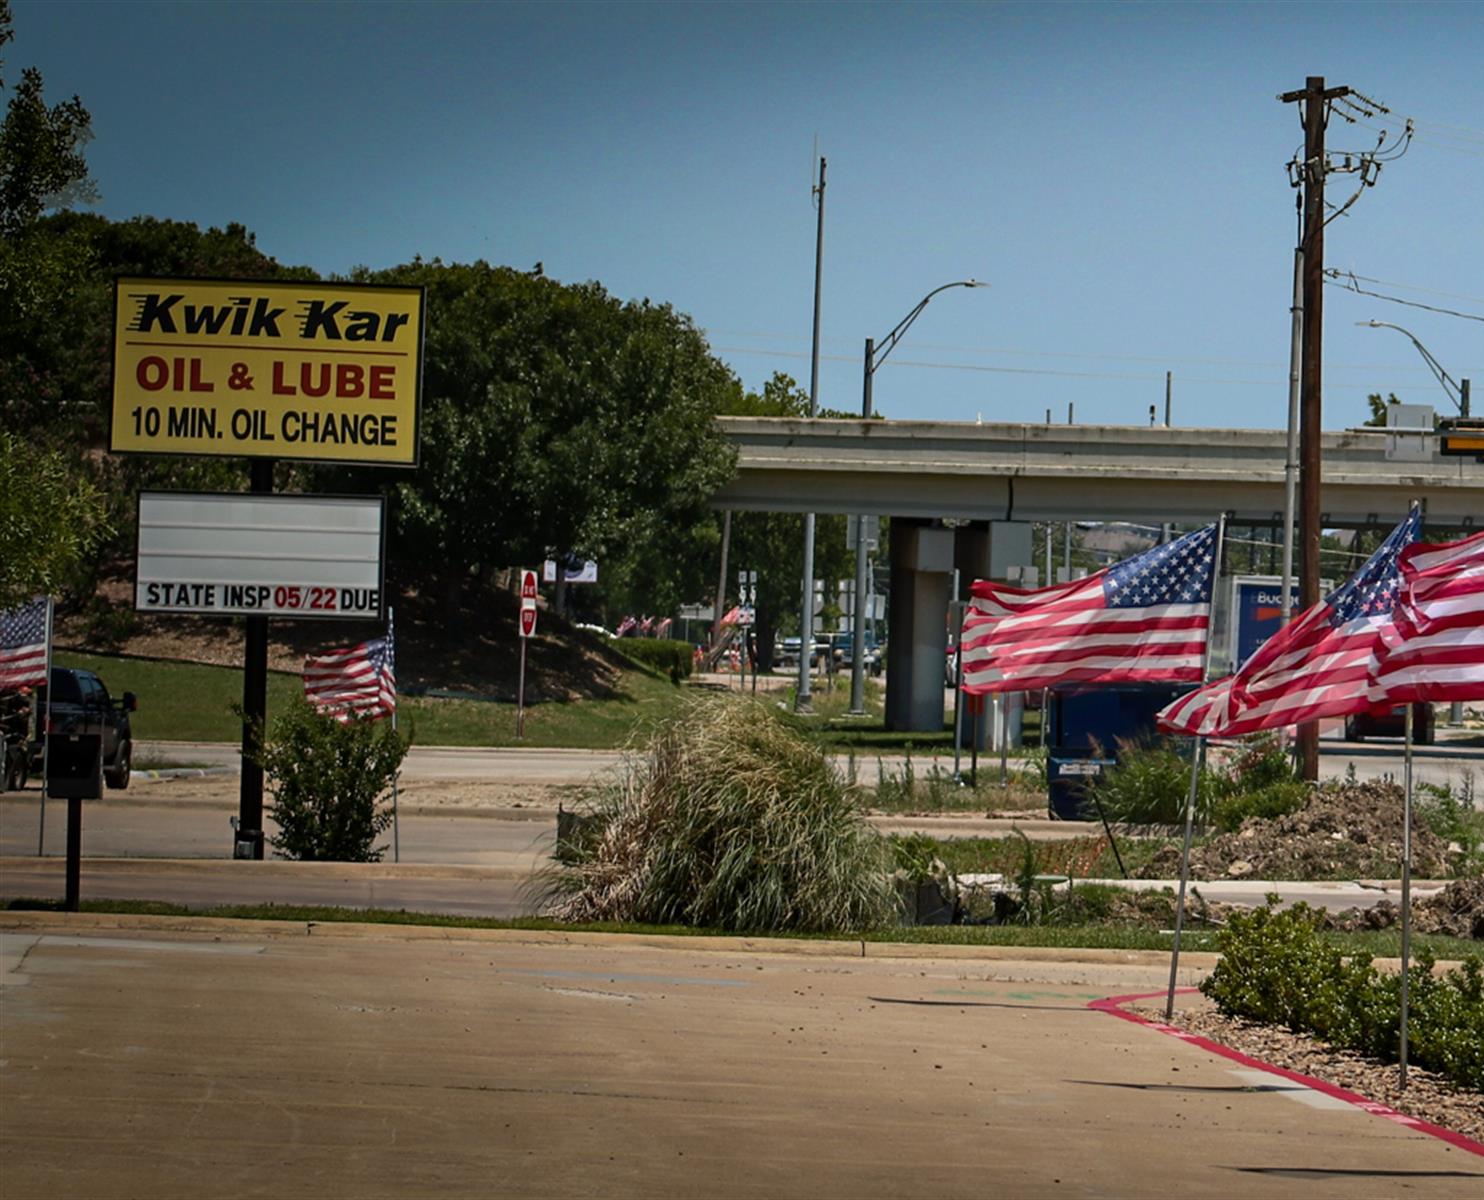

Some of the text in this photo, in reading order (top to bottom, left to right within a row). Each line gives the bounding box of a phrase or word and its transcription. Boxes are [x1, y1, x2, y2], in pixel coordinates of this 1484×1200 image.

[126, 293, 409, 343] Kwik Kar
[136, 355, 396, 400] OIL & LUBE
[132, 406, 397, 446] 10 MIN. OIL CHANGE
[147, 583, 379, 611] STATE INSP 05/22 DUE
